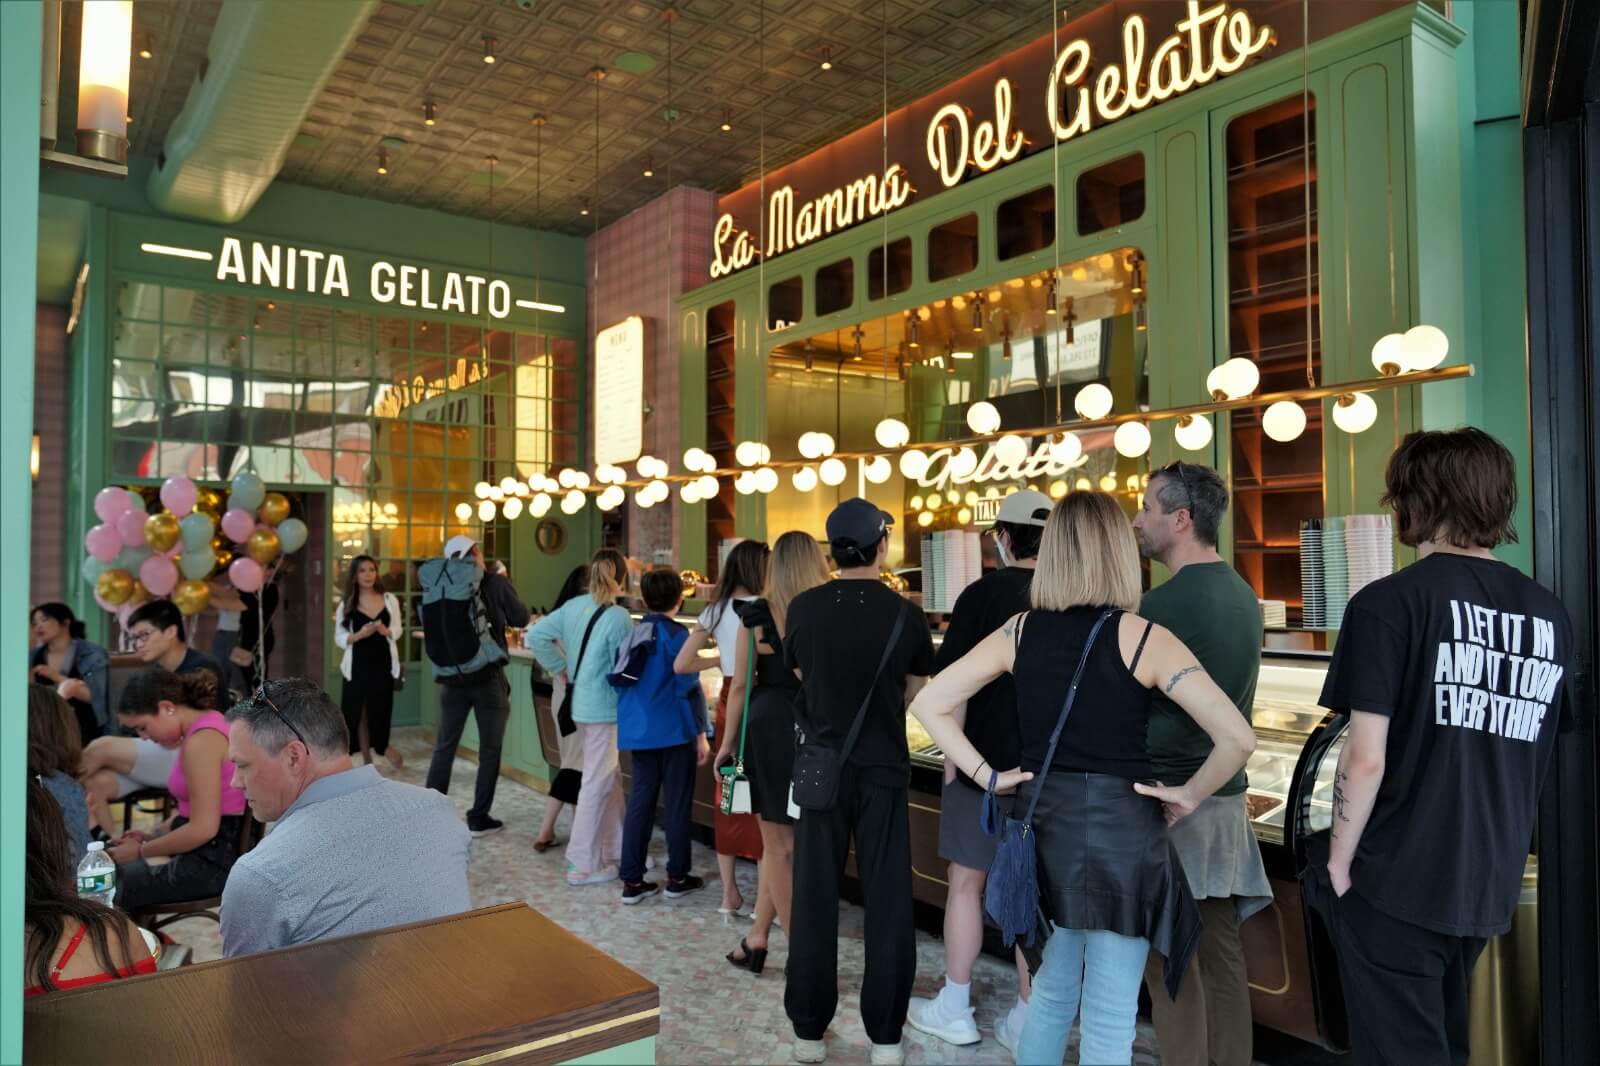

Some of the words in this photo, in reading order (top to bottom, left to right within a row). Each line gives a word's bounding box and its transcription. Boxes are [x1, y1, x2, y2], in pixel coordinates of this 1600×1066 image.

[710, 213, 754, 278] La
[766, 164, 910, 257] Mamma
[927, 78, 1023, 187] Del
[1047, 0, 1270, 139] Gelato
[217, 237, 349, 297] ANITA
[371, 260, 511, 319] GELATO
[1450, 599, 1462, 640] I
[1464, 601, 1497, 648] LET
[1501, 612, 1526, 653] IT
[1532, 616, 1555, 661] IN
[1434, 642, 1484, 686] AND
[1486, 649, 1505, 692] IT
[1508, 655, 1564, 704] TOOK
